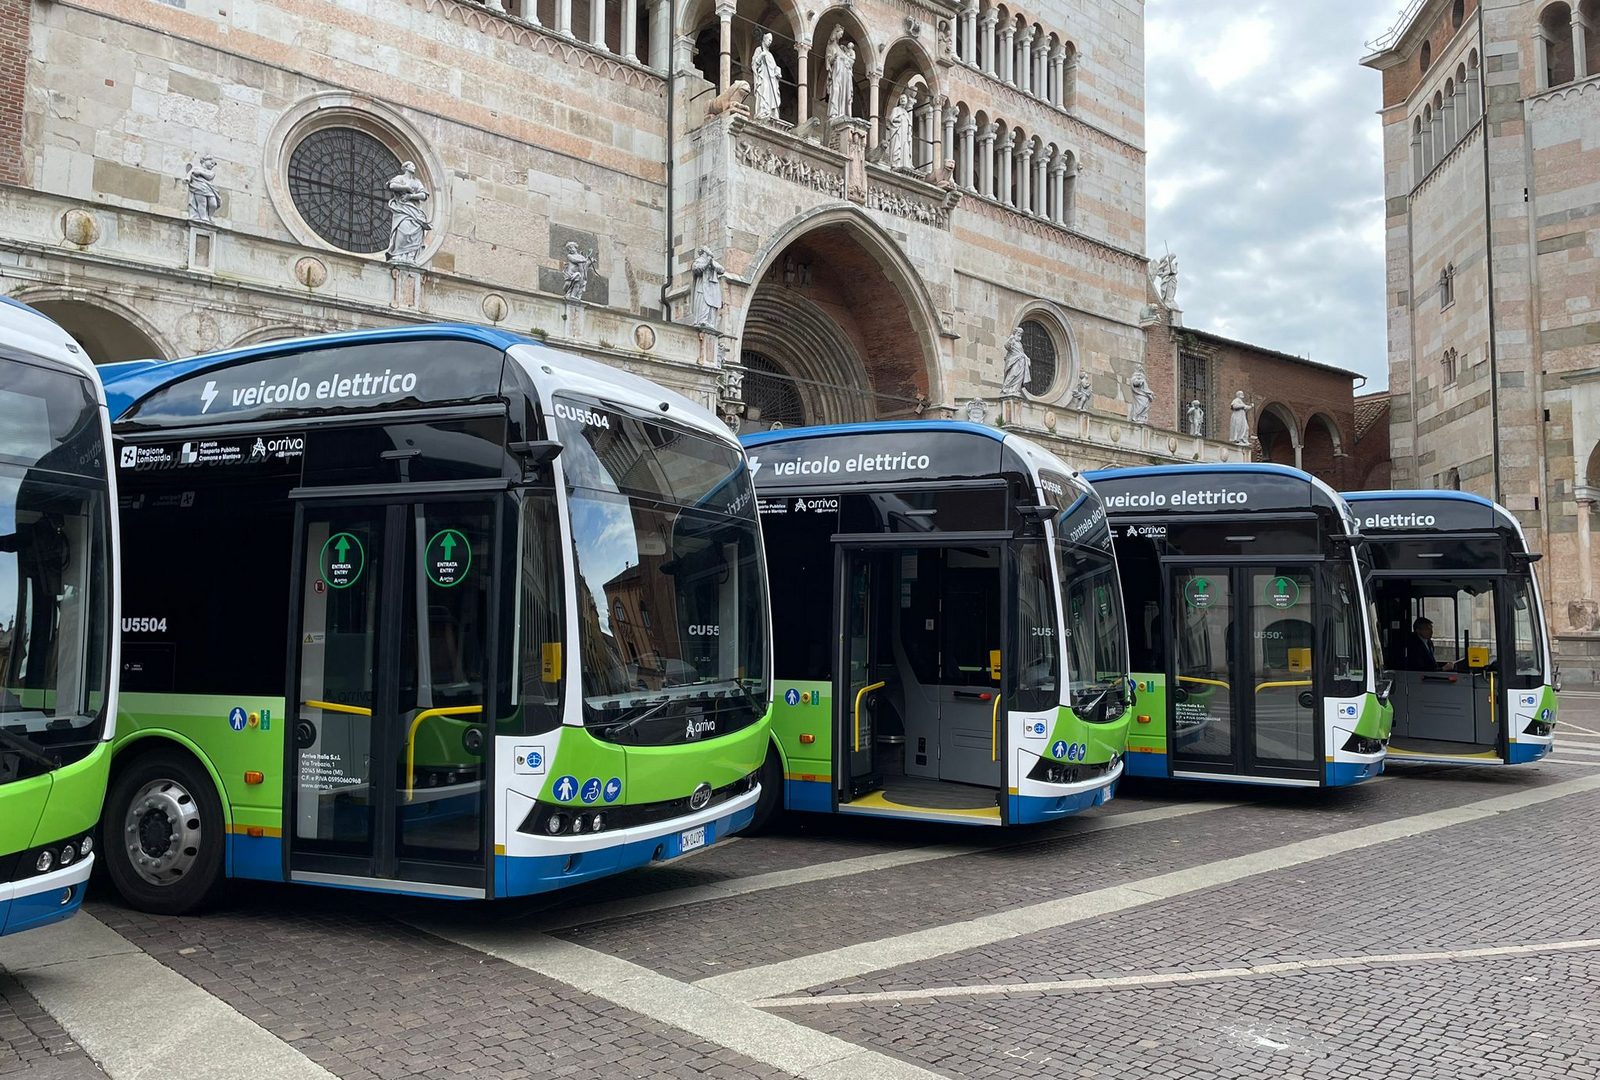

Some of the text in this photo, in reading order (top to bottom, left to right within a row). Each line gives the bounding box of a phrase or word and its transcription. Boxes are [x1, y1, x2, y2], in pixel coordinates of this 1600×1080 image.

[232, 369, 416, 406] veicolo elettrico
[555, 403, 610, 430] CU5504
[268, 436, 304, 451] arriva
[136, 454, 171, 463] Lombardia
[138, 448, 164, 456] Regione
[774, 452, 930, 476] veicolo elettrico
[808, 498, 838, 509] arriva
[1105, 489, 1248, 507] veicolo elettrico
[1365, 512, 1435, 527] elettrico
[1138, 526, 1166, 534] arriva
[120, 618, 167, 632] U5504
[688, 625, 720, 635] CU55
[695, 719, 715, 732] arriva
